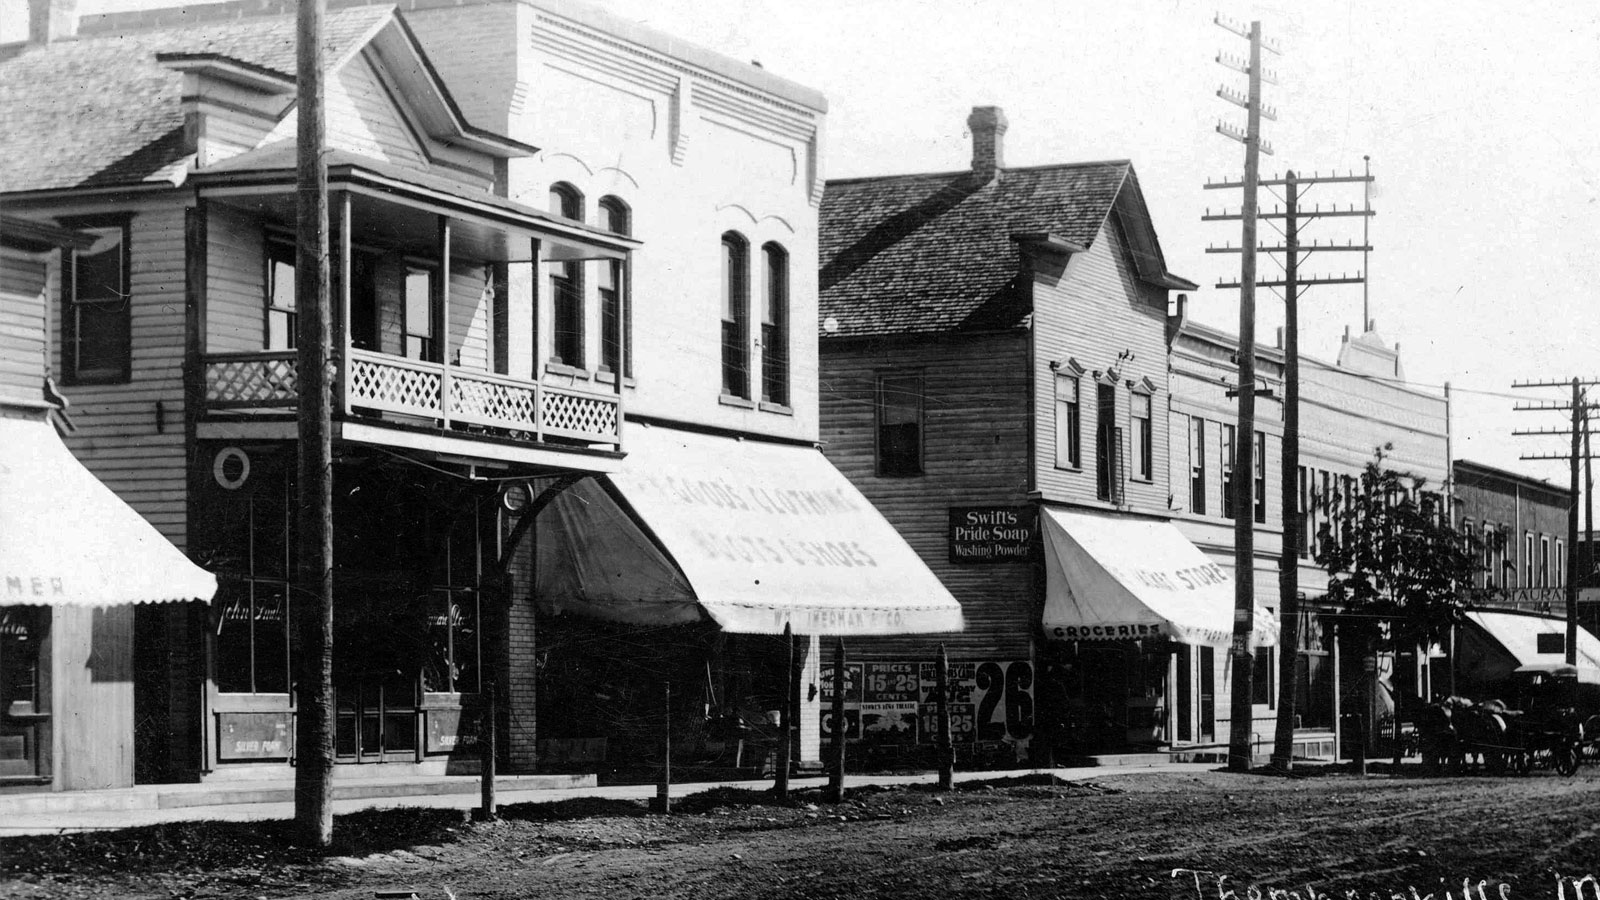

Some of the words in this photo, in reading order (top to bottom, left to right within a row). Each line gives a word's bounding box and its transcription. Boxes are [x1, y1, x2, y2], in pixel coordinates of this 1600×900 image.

[966, 510, 1018, 526] Swift's
[955, 526, 991, 541] Pride
[993, 526, 1029, 543] Soap
[955, 544, 993, 559] Washing
[994, 543, 1030, 556] Powder
[1175, 562, 1229, 591] STORE
[1053, 624, 1161, 638] GROCERIES
[871, 664, 912, 673] PRICES
[867, 674, 888, 692] 15
[895, 674, 919, 692] 25
[876, 693, 908, 701] CENTS
[976, 661, 1033, 740] 26
[926, 704, 968, 713] PCES
[951, 714, 974, 732] 25
